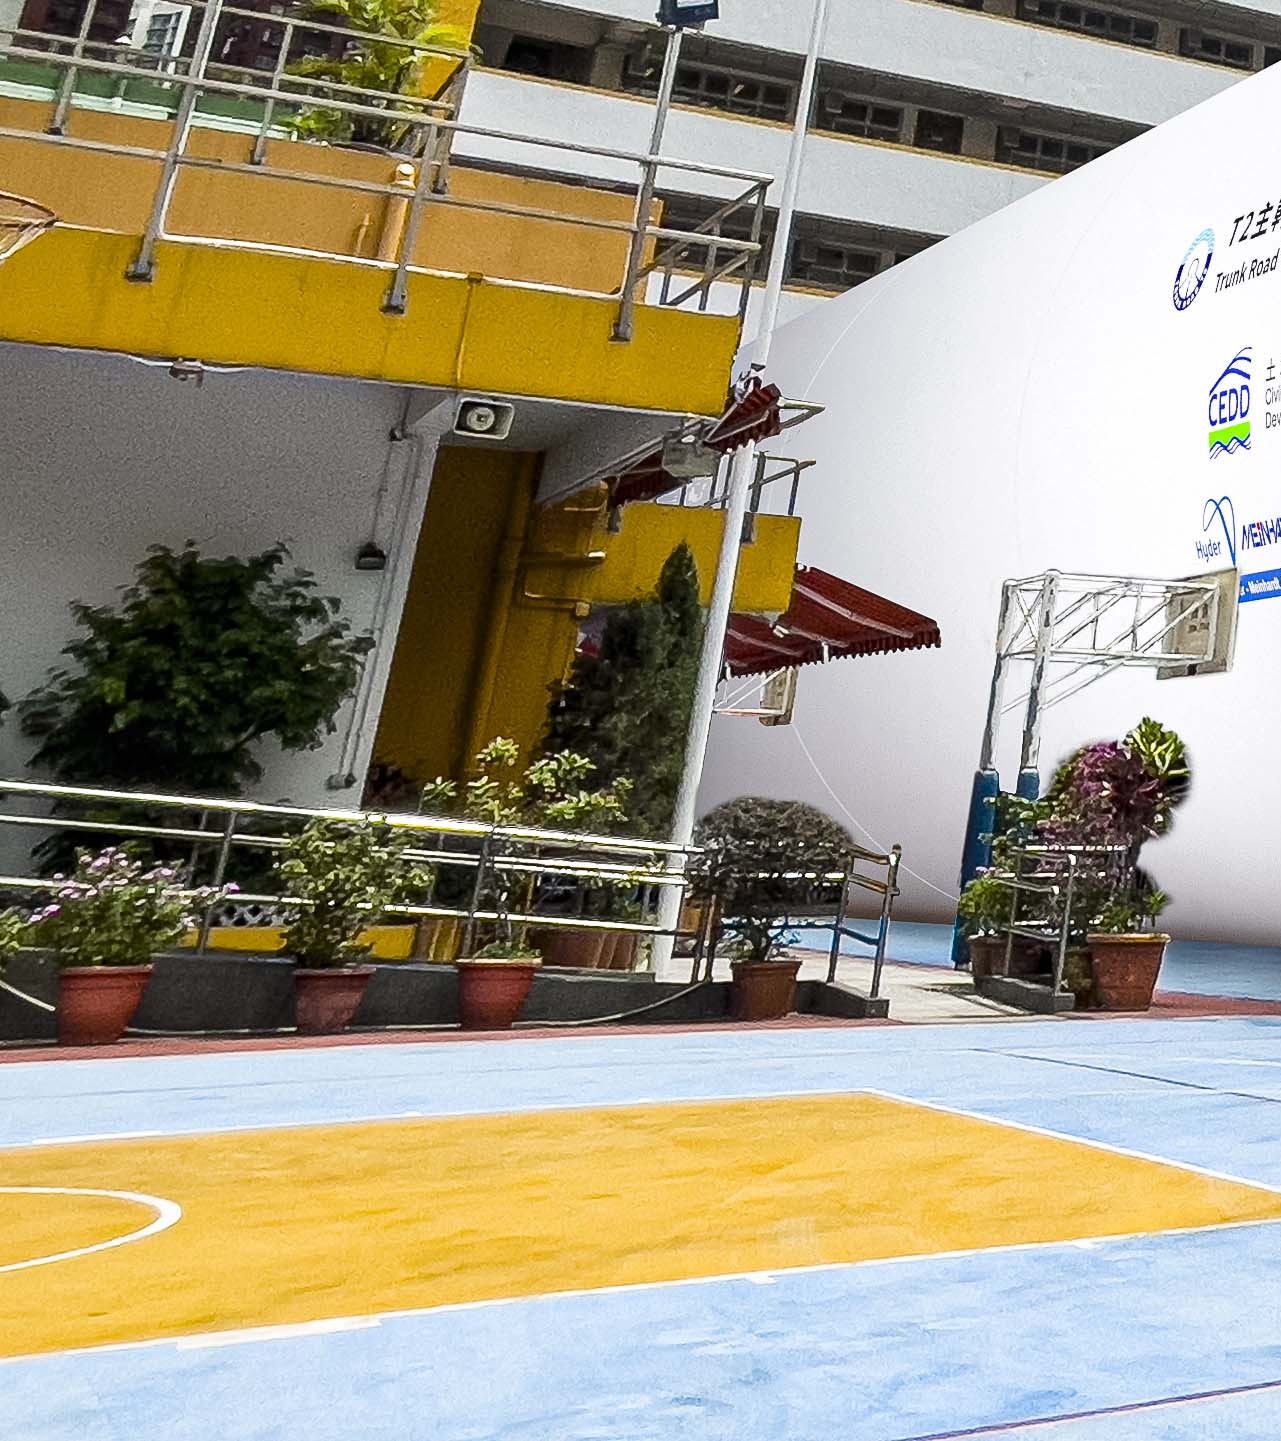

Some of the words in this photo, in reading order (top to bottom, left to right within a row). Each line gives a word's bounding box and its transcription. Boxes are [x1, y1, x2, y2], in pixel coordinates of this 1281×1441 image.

[1215, 262, 1247, 293] Trunk
[1248, 248, 1279, 279] Road
[1209, 385, 1250, 426] CEDD
[1196, 539, 1221, 563] Hyder
[1247, 576, 1281, 595] Meinhardt
